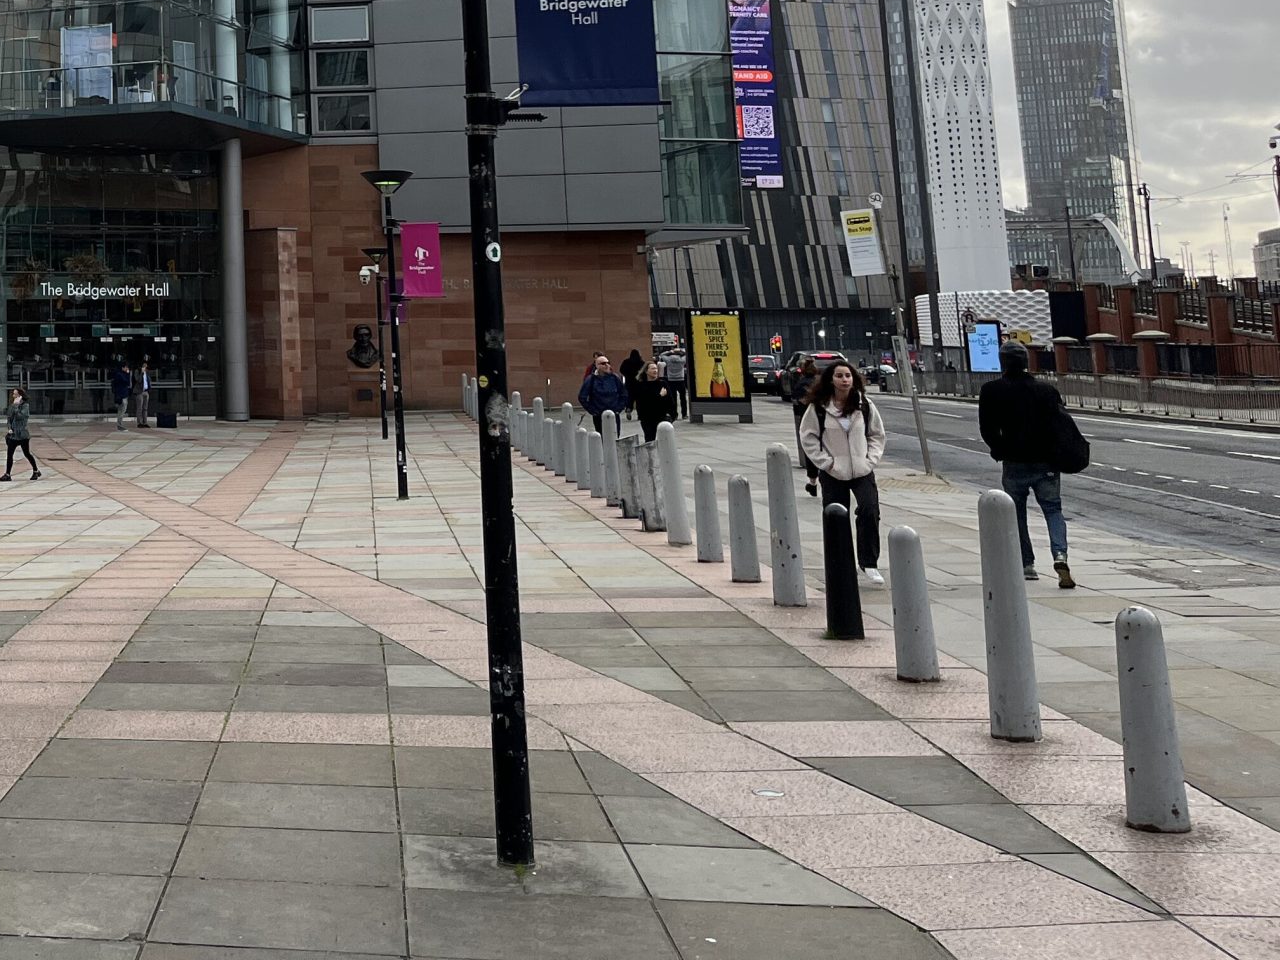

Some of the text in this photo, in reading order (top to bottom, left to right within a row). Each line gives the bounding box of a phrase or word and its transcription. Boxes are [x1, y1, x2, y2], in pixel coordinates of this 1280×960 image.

[571, 11, 599, 25] Hall
[870, 194, 882, 202] SQ
[542, 279, 568, 289] HALL
[40, 282, 170, 300] The Bridgewater Hall
